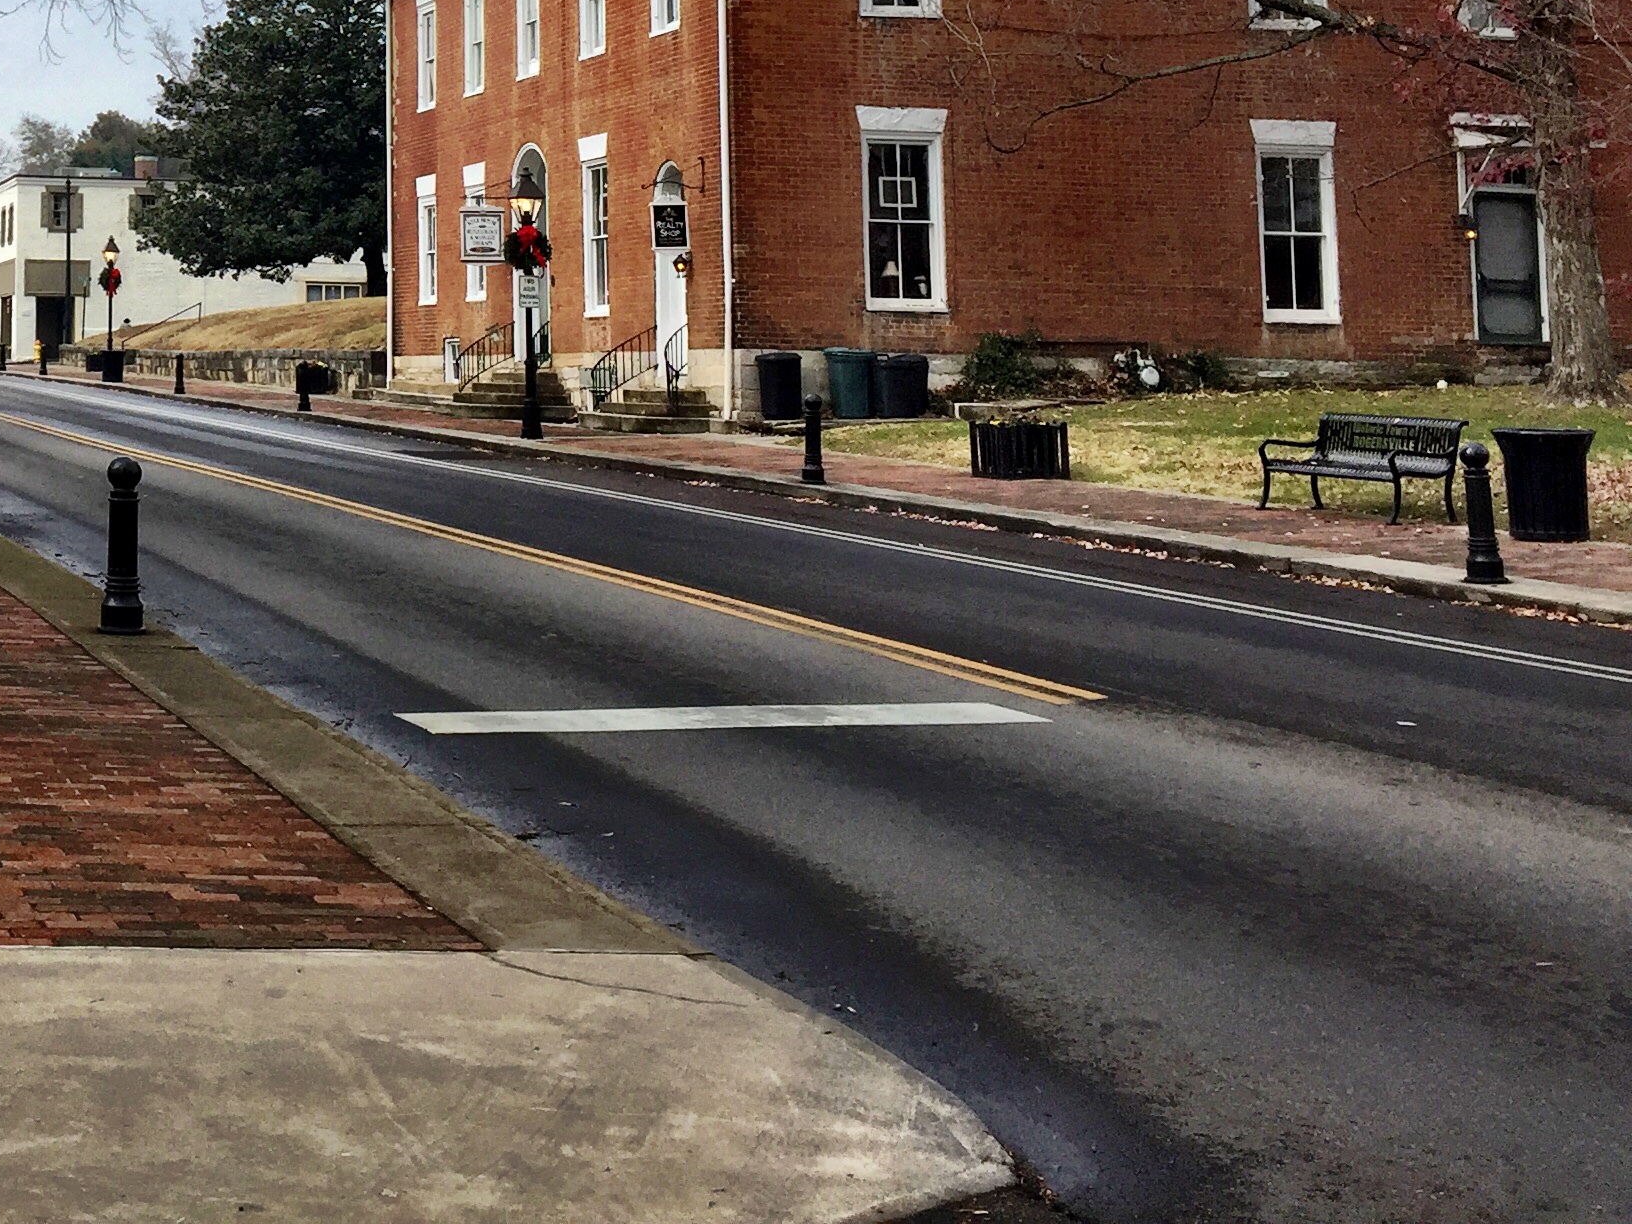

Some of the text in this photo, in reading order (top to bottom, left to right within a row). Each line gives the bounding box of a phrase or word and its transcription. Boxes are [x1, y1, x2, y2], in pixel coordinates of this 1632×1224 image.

[655, 220, 684, 229] REALTY
[660, 228, 681, 237] SHOP
[1352, 435, 1416, 452] ROGERSVILLE
